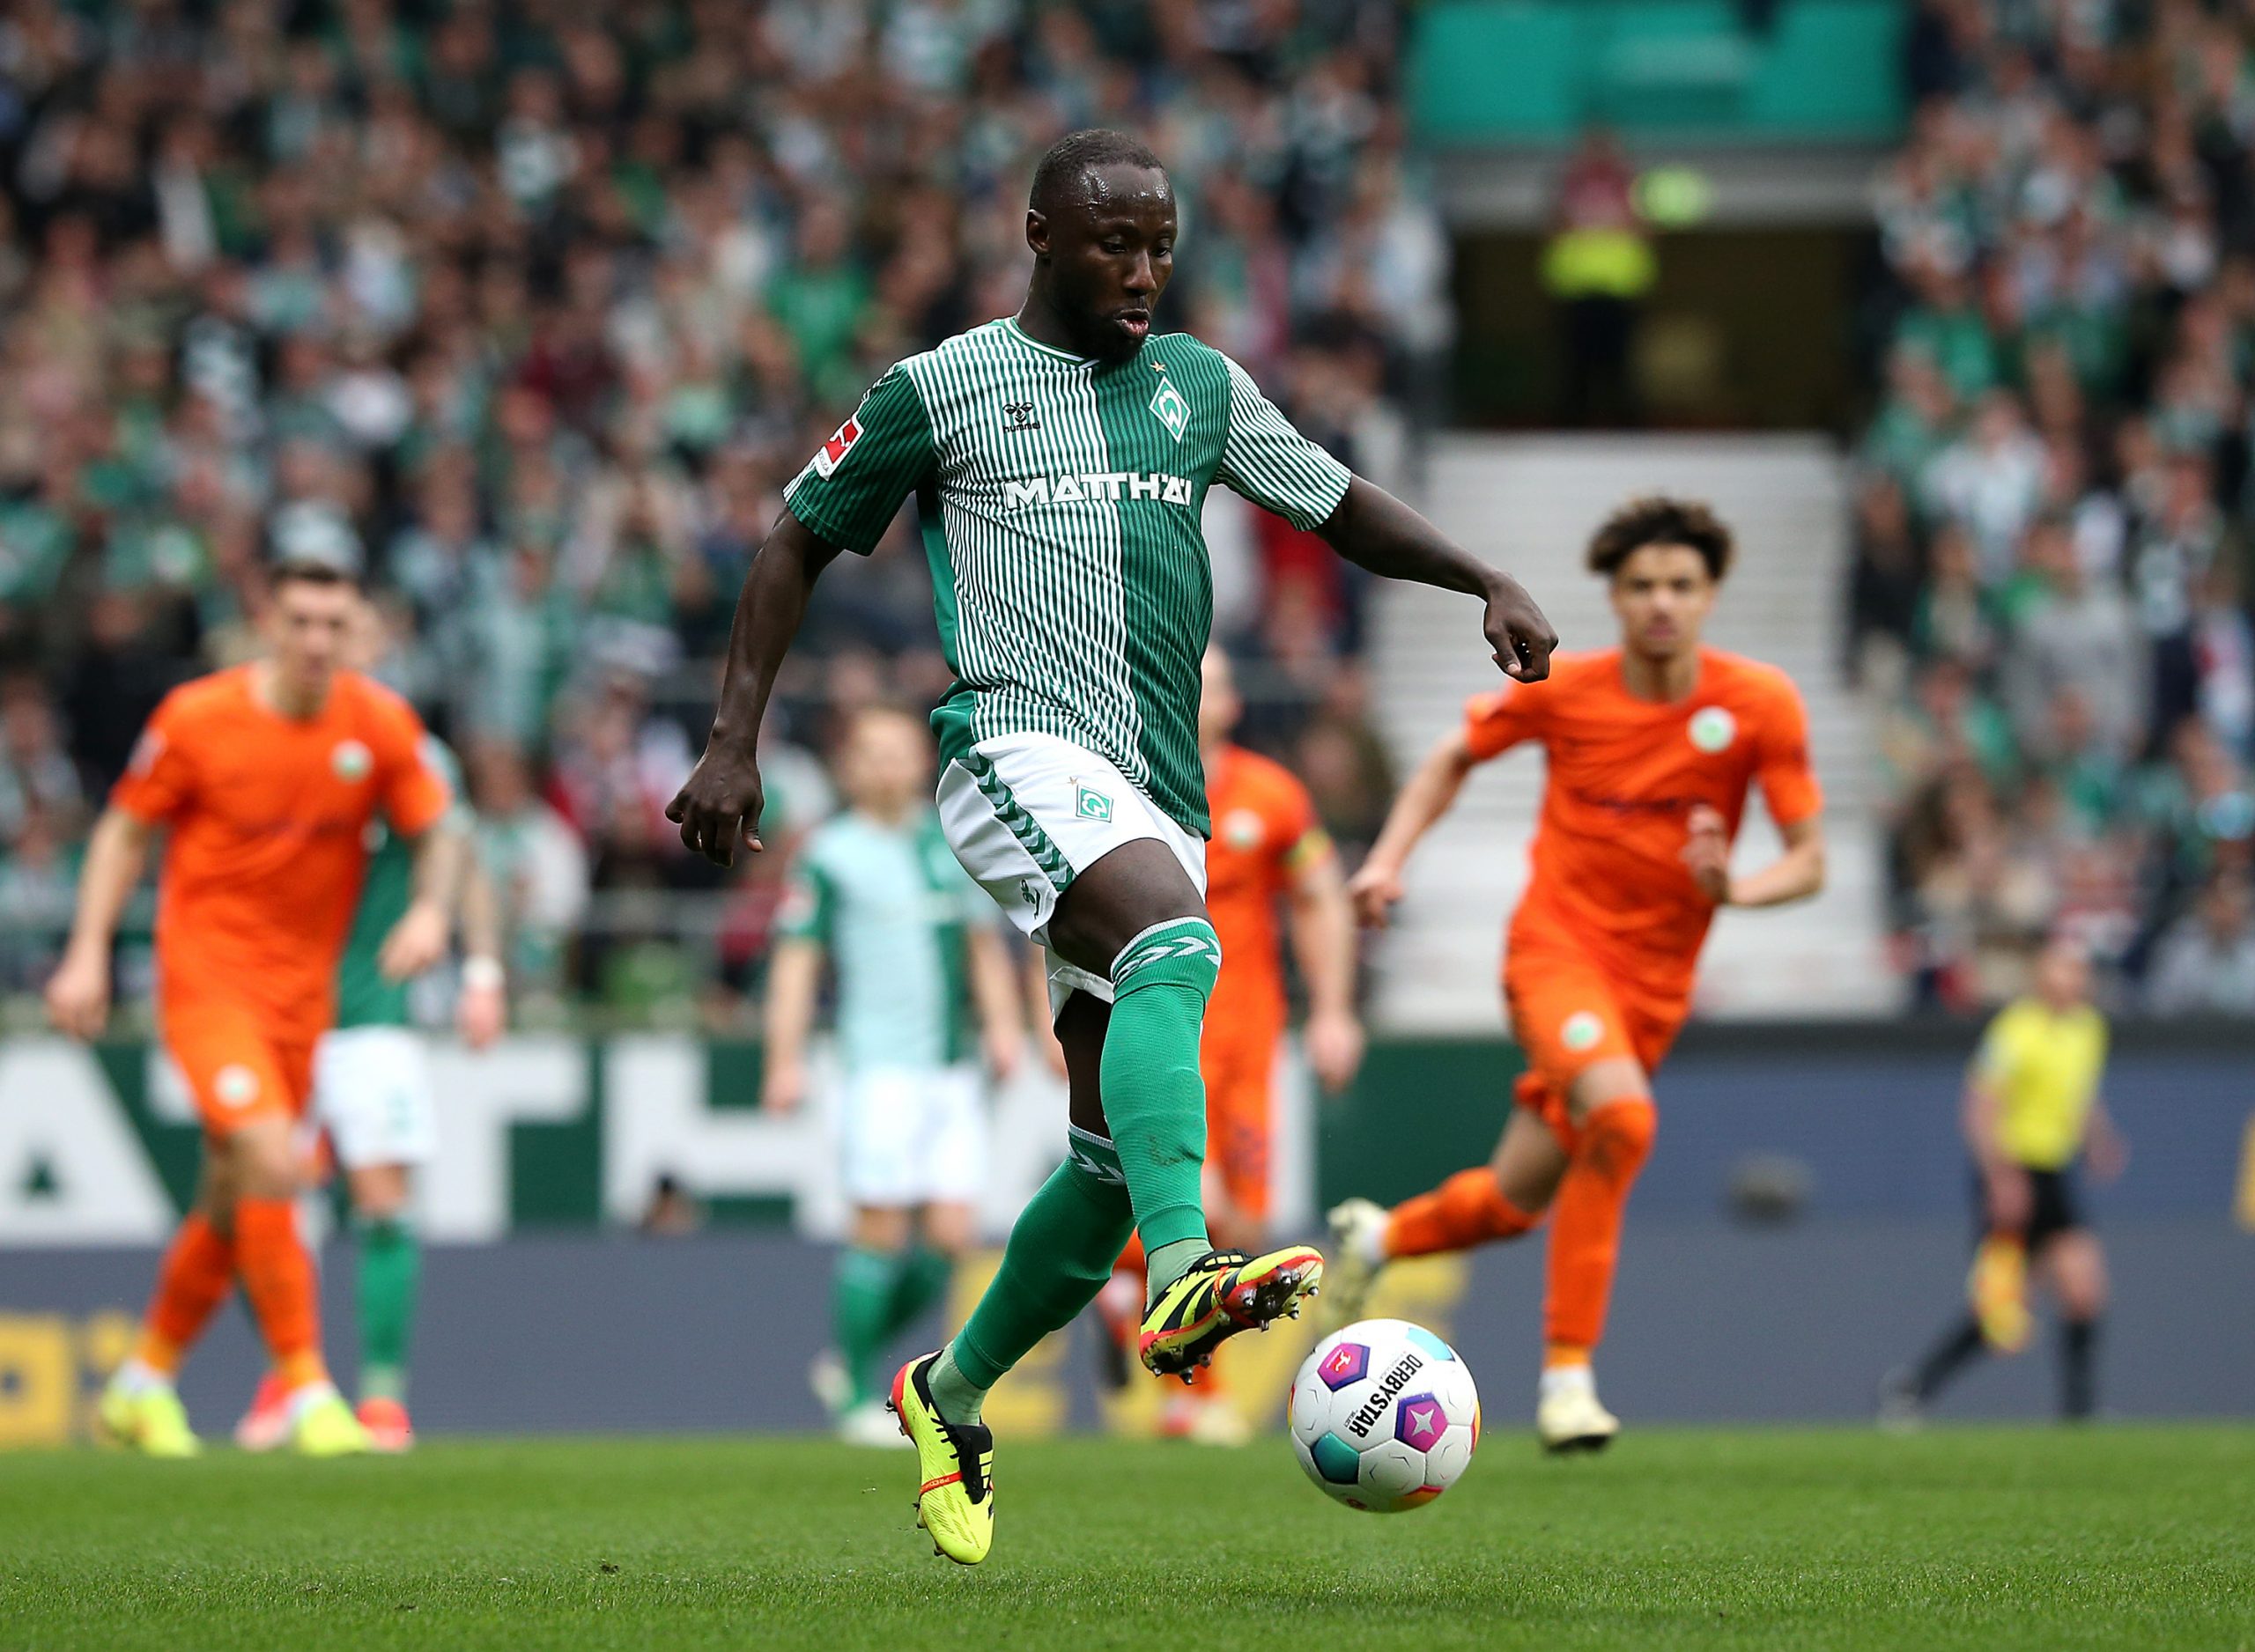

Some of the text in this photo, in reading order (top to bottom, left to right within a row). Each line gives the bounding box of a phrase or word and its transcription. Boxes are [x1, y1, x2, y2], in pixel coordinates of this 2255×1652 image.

[1002, 420, 1040, 434] hummel
[1003, 472, 1192, 509] MATTHÄI
[1348, 1353, 1423, 1439] DERBYSTAR
